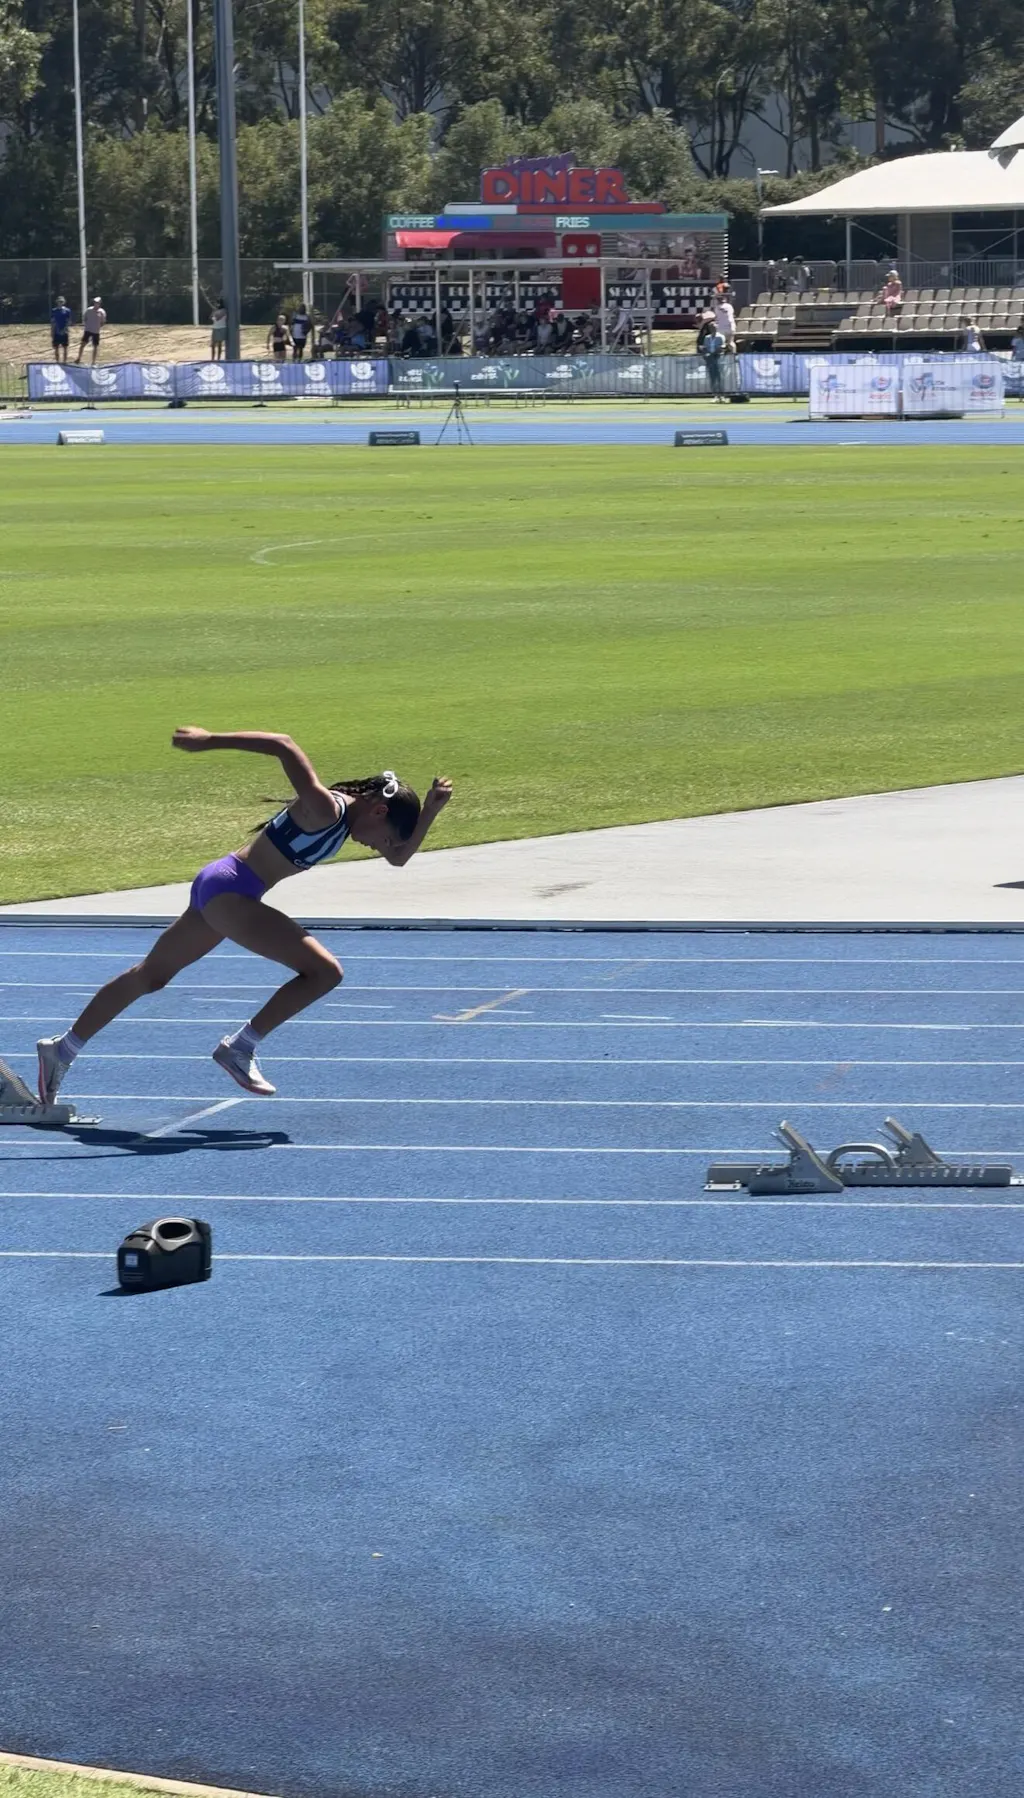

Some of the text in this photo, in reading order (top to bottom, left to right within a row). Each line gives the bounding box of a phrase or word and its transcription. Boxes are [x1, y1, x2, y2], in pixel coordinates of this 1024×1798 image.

[482, 168, 629, 204] DINER
[389, 217, 434, 228] COFFEE
[555, 216, 590, 228] FRIES
[392, 287, 437, 297] COFFE
[448, 287, 512, 297] BUGERS
